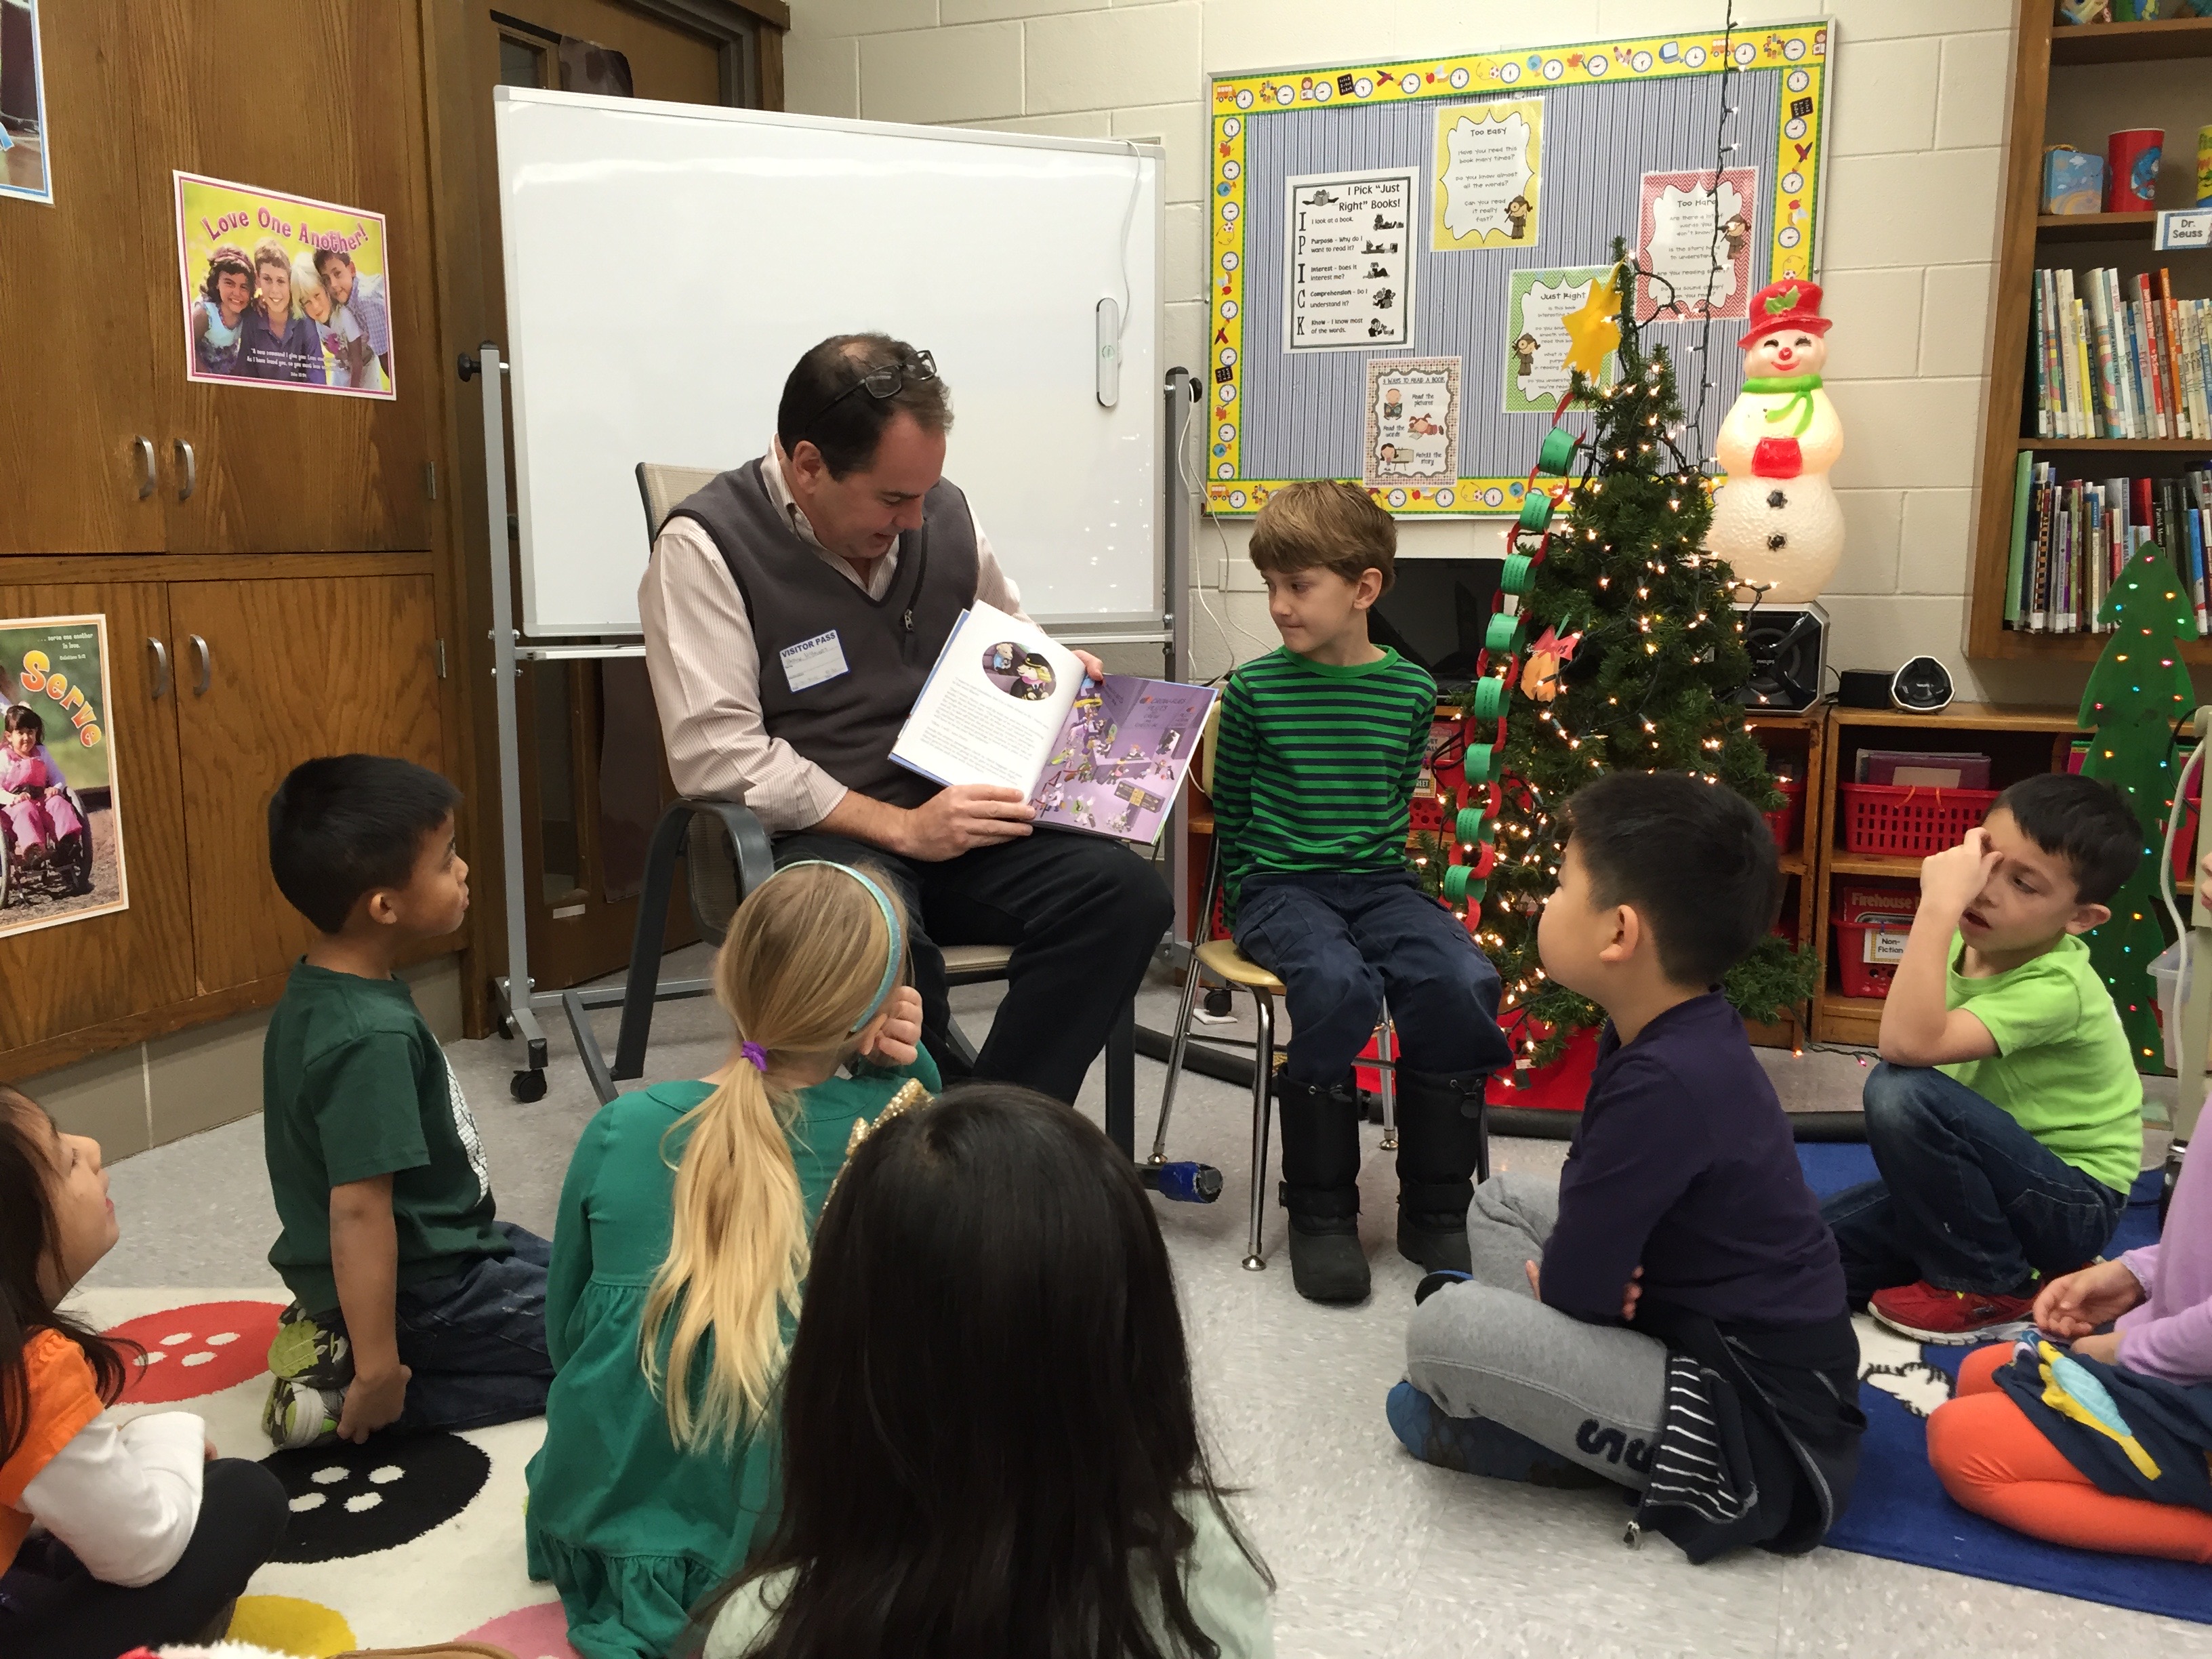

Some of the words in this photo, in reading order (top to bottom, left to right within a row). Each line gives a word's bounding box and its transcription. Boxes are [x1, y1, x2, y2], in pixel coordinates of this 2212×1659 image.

[1348, 186, 1350, 195] I
[1354, 185, 1372, 195] Pick
[1372, 199, 1400, 209] Books!
[201, 212, 249, 241] Love
[258, 207, 291, 237] One
[299, 223, 368, 253] Another!
[1298, 212, 1307, 231] I
[2182, 220, 2196, 228] Dr.
[2173, 229, 2203, 238] Seuss
[1298, 236, 1305, 255] P
[1298, 264, 1305, 283] I
[1298, 289, 1305, 308] C
[1563, 292, 1586, 300] Right
[1297, 316, 1305, 335] K
[782, 641, 815, 657] VISITOR
[815, 632, 836, 645] PASS
[21, 650, 102, 747] Serve
[1851, 893, 1912, 909] Firehouse
